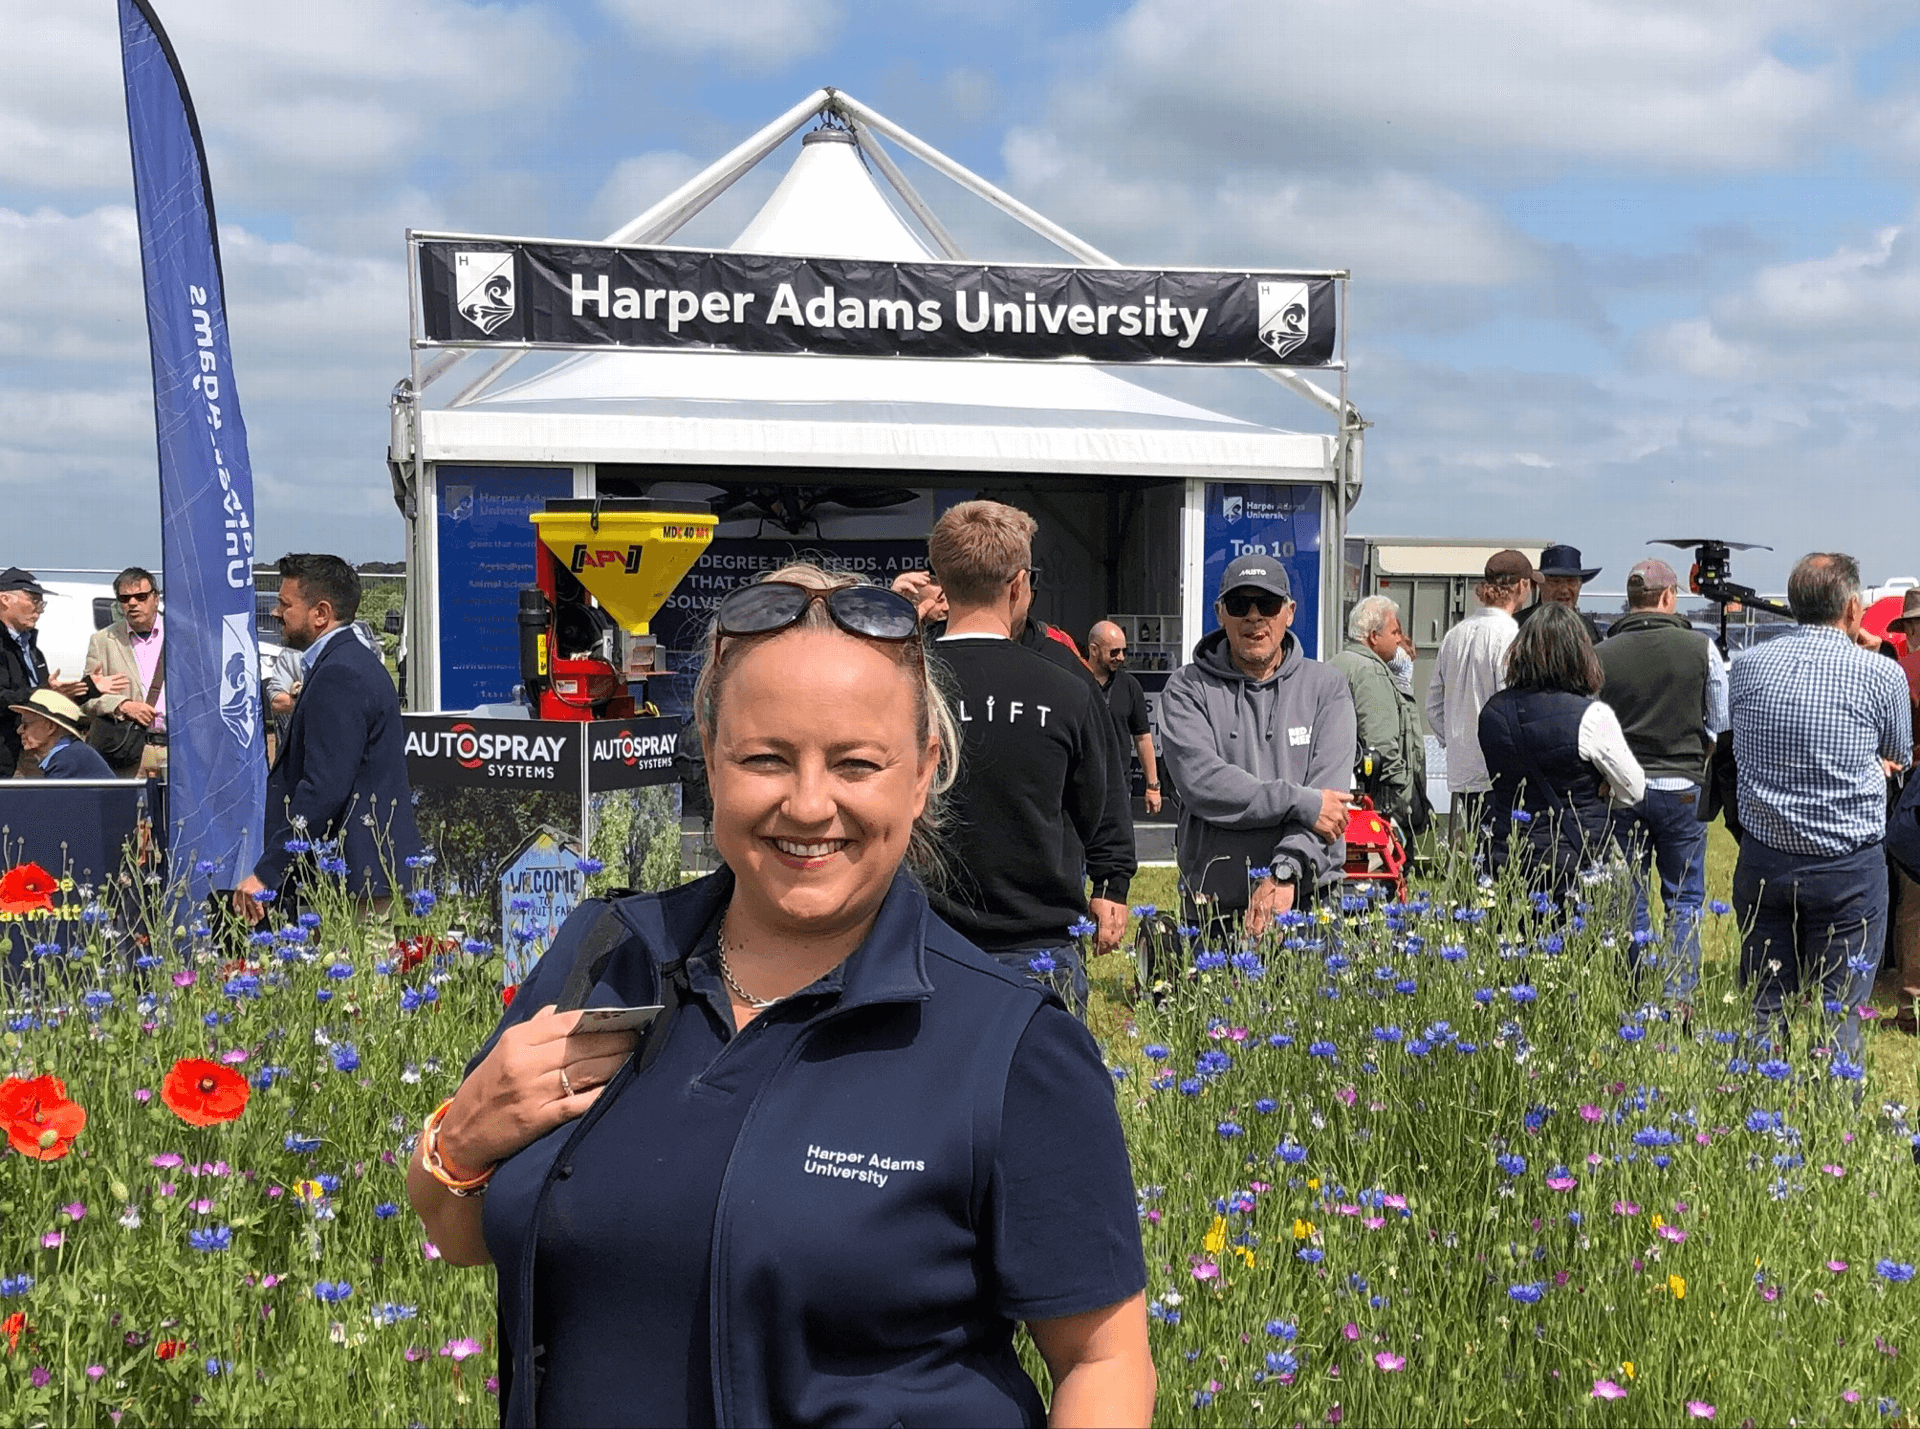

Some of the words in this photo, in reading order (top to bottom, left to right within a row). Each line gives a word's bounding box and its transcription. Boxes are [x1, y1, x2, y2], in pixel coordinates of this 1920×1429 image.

[571, 273, 755, 333] Harper
[765, 283, 943, 332] Adams
[955, 290, 1209, 349] University
[1246, 502, 1275, 512] Harper
[1271, 541, 1295, 558] 10
[699, 555, 769, 570] DEGREE
[886, 557, 898, 570] A
[687, 574, 736, 590] THAT
[960, 695, 1052, 728] LIFT
[404, 731, 567, 763] AUTOSPRAY
[592, 733, 678, 762] AUTOSPRAY
[487, 764, 555, 780] SYSTEMS
[638, 757, 673, 770] SYSTEMS
[510, 869, 579, 894] WCOME
[806, 1144, 865, 1165] Harper
[868, 1152, 926, 1172] Adams
[803, 1159, 889, 1189] University
